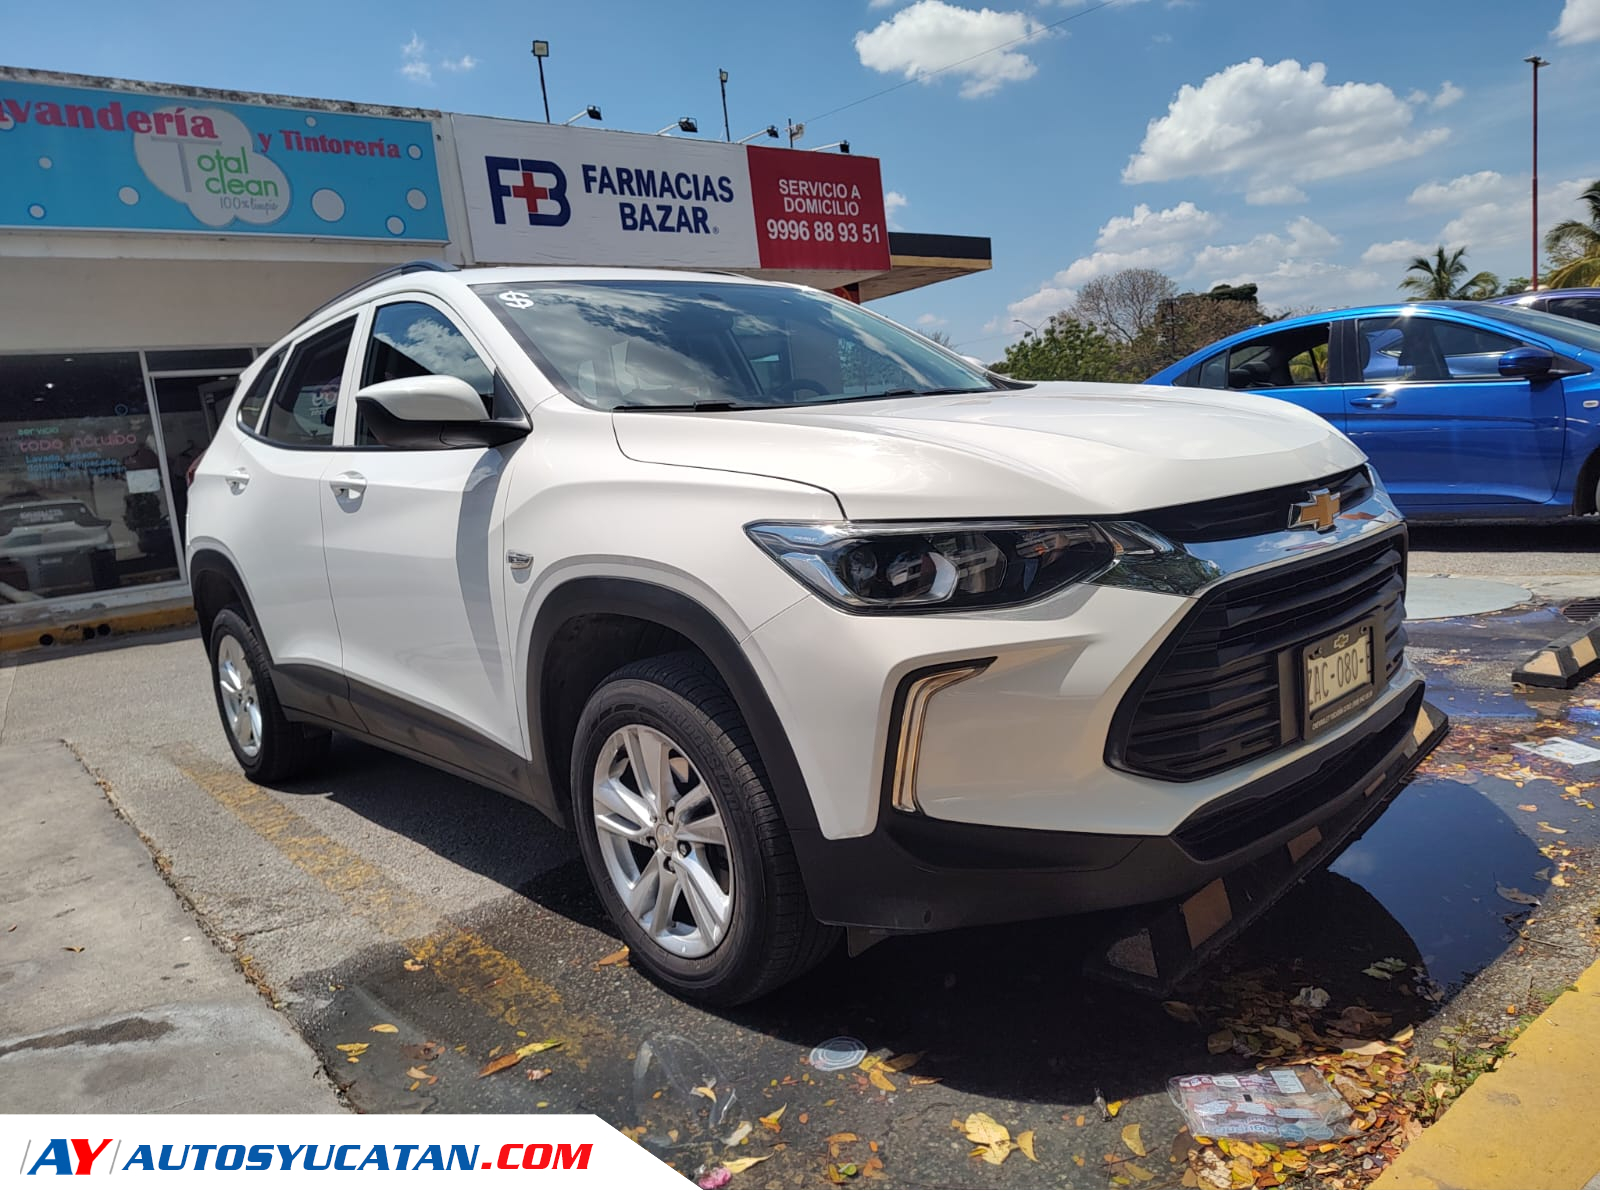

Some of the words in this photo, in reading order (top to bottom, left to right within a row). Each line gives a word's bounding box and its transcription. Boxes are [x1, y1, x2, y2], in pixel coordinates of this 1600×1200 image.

[0, 98, 219, 139] vandería
[257, 132, 272, 153] y
[279, 129, 402, 159] Tintorería
[205, 177, 279, 197] clean
[582, 164, 734, 203] FARMACIAS
[779, 179, 847, 199] SERVICIO
[851, 184, 861, 200] A
[784, 197, 859, 216] DOMICILIO
[766, 218, 811, 241] 9996
[813, 221, 835, 242] 88
[838, 222, 859, 243] 93
[862, 223, 880, 244] 51
